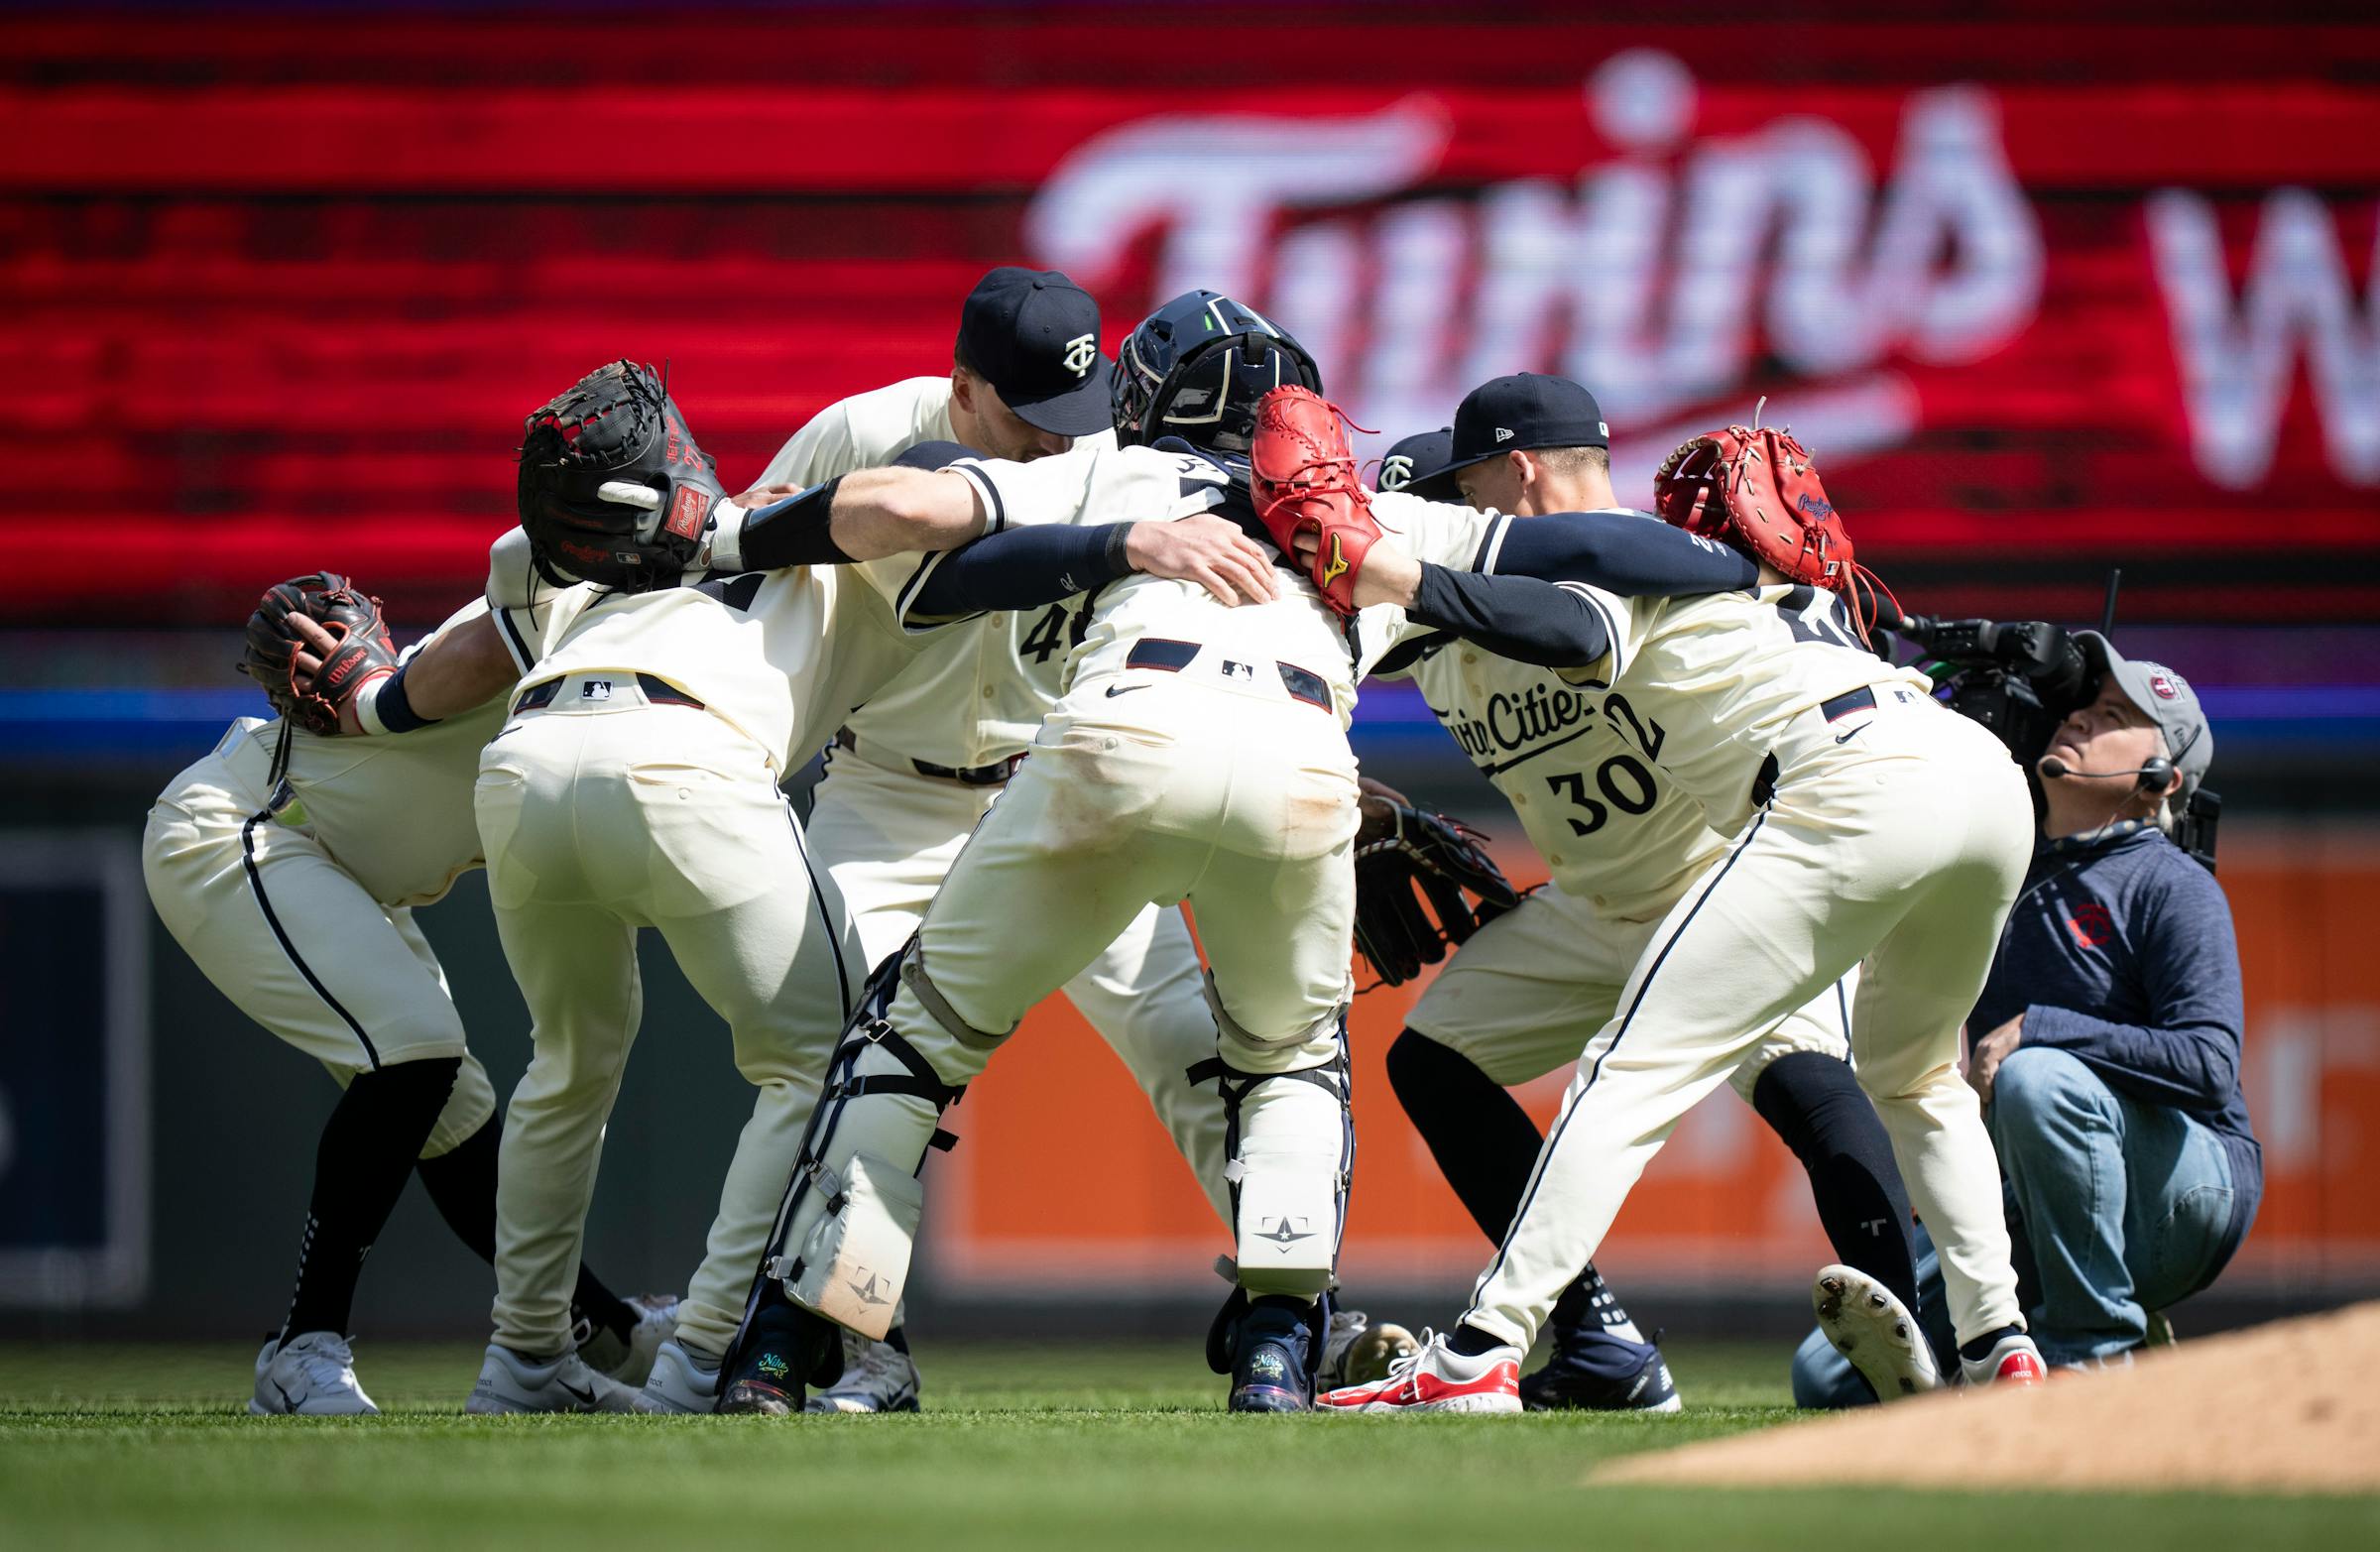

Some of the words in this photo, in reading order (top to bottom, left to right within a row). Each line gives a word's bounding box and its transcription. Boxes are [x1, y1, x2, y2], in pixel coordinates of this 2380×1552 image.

[1024, 48, 2045, 466] Twins
[683, 443, 703, 473] 27
[1019, 602, 1084, 664] 4
[327, 648, 367, 684] Wilson
[1545, 754, 1658, 837] 30
